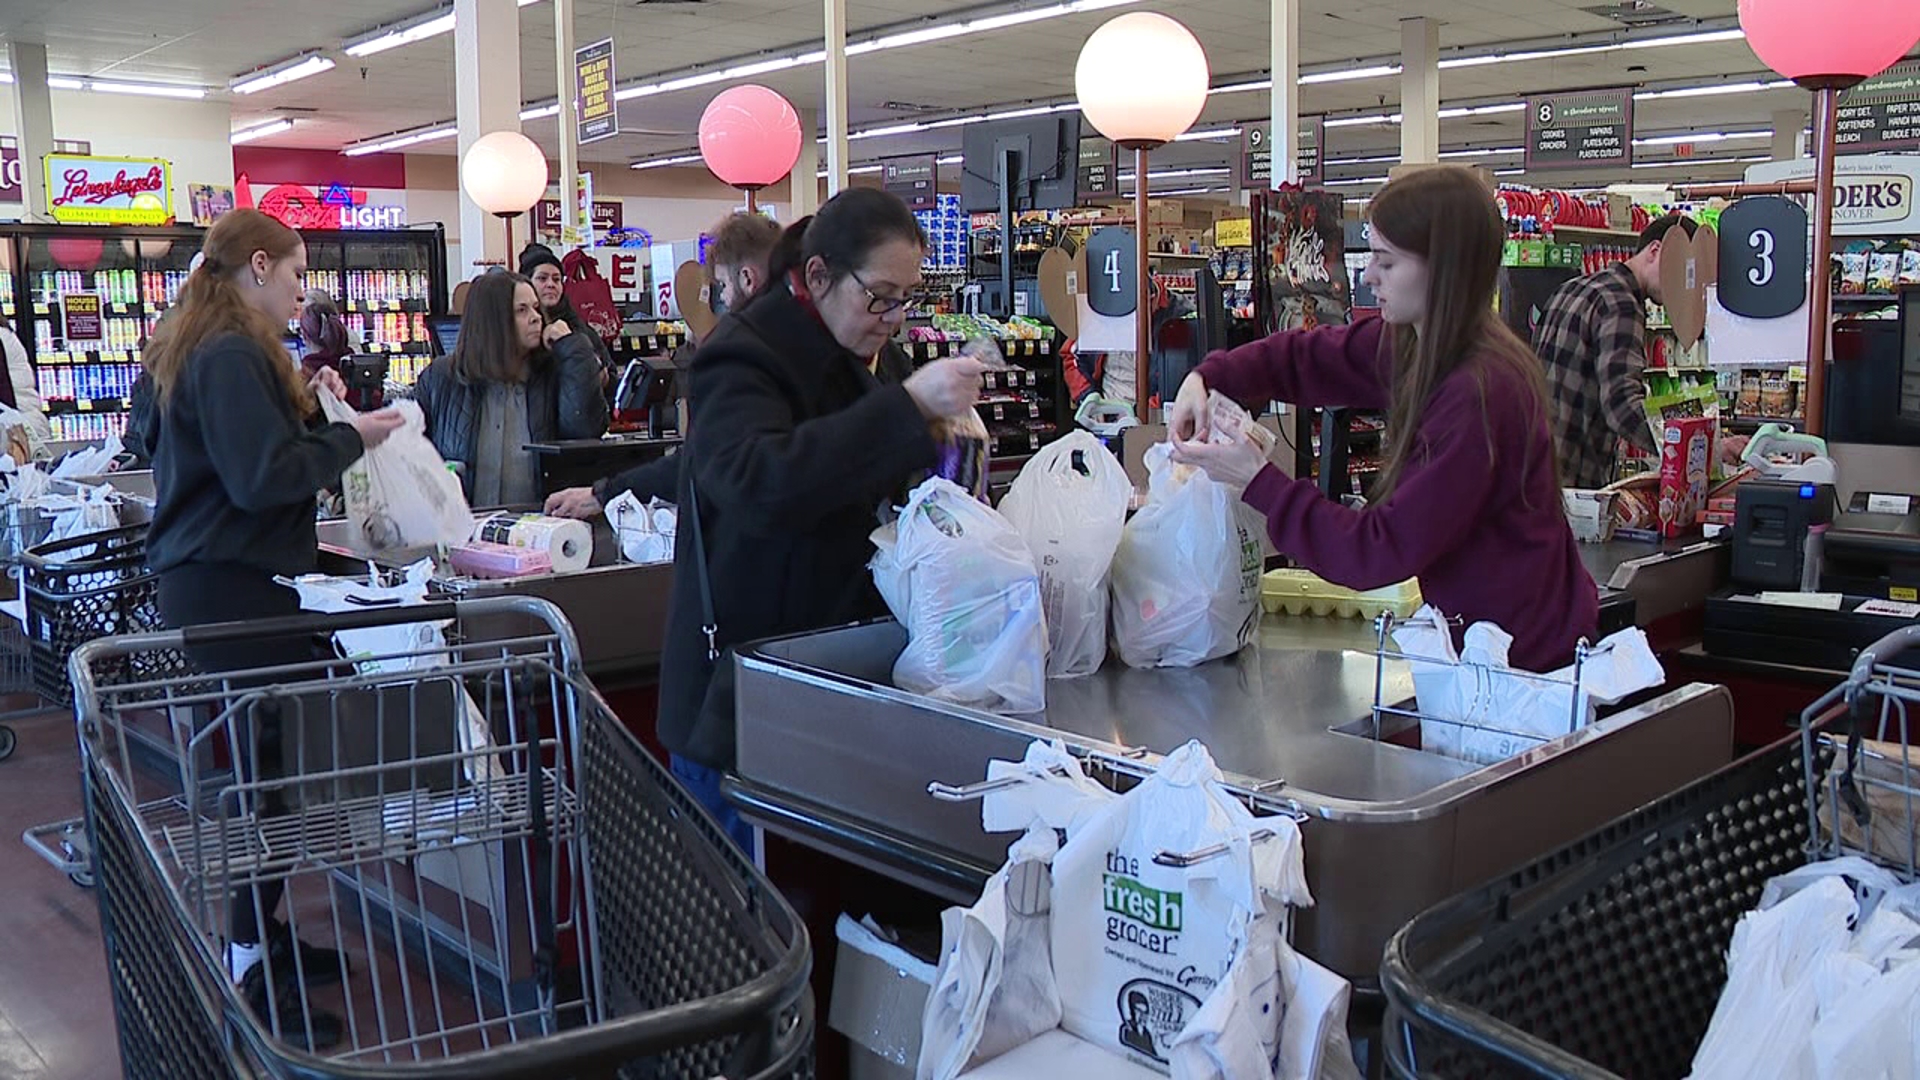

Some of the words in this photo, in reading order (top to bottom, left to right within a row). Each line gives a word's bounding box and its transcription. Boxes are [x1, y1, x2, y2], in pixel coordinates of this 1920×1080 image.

[1540, 105, 1551, 121] 8
[1835, 109, 1856, 118] NDRY
[1886, 103, 1908, 114] PAPER
[1836, 119, 1876, 130] SOFTENERS
[1251, 131, 1261, 145] 9
[1541, 130, 1566, 139] COOKIES
[1835, 133, 1861, 143] BLEACH
[1882, 128, 1909, 140] BUNDLE
[1539, 140, 1567, 150] CRACKERS
[59, 210, 111, 220] SUMMER
[115, 212, 162, 222] SHANDY
[340, 206, 402, 228] LIGHT
[1747, 229, 1776, 286] 3
[611, 252, 637, 289] E
[1103, 249, 1121, 292] 4
[1106, 846, 1139, 877] the
[1104, 875, 1181, 930] fresh
[1106, 915, 1177, 956] grocer
